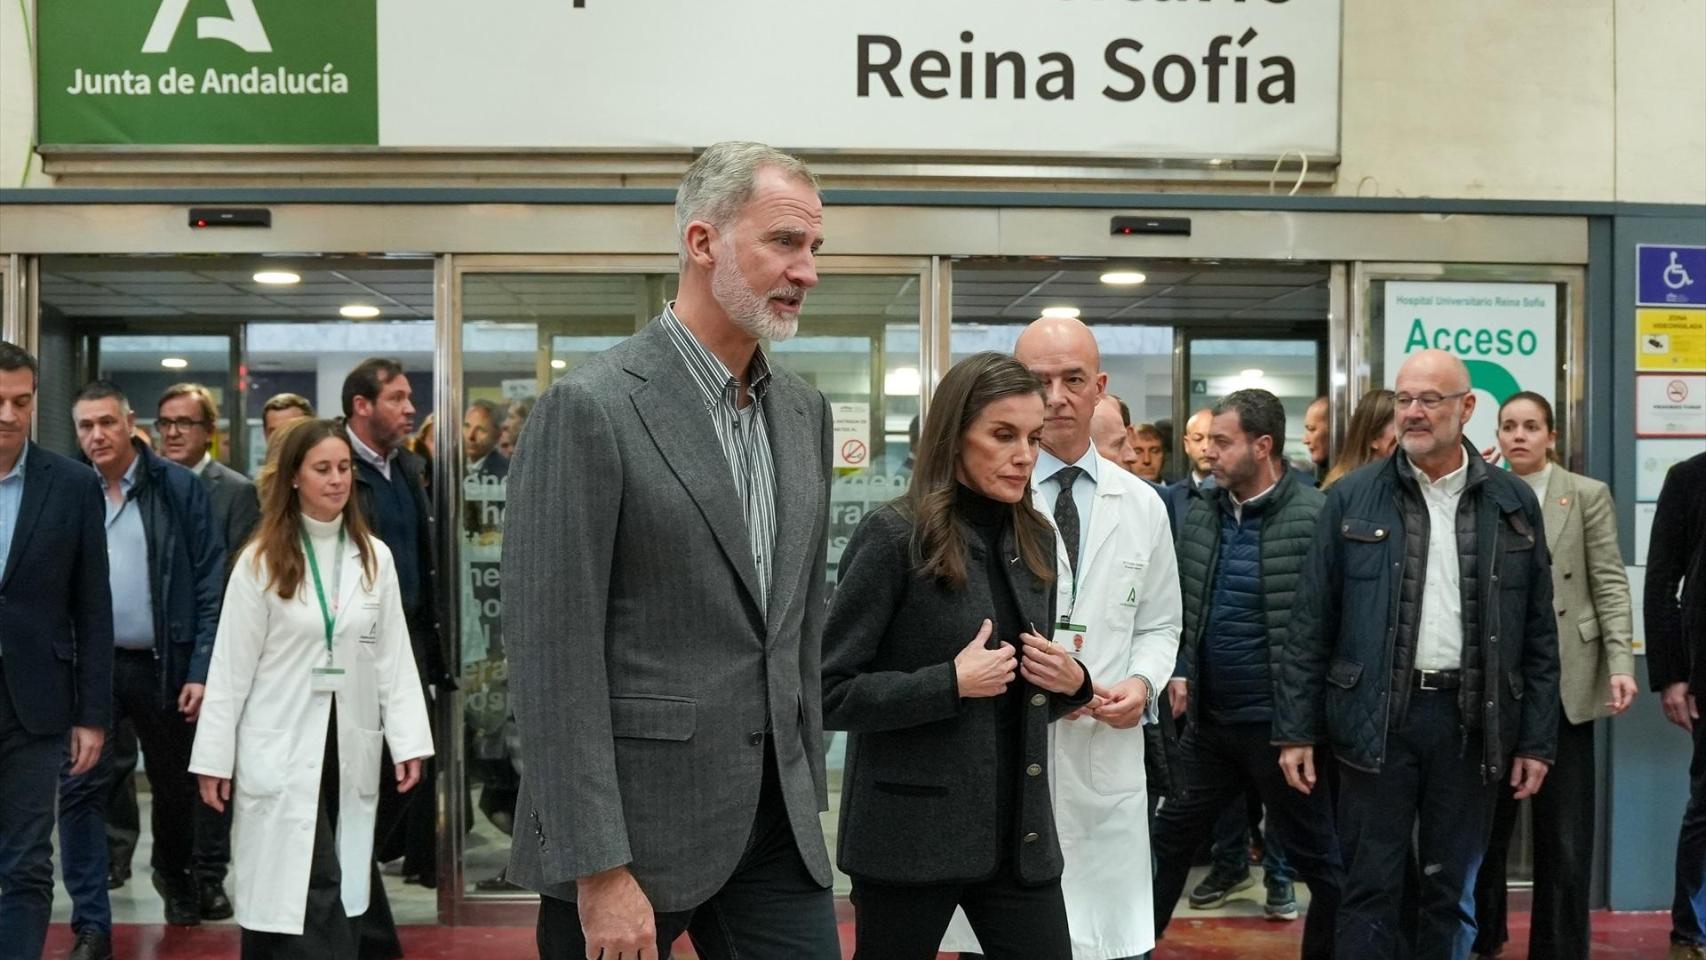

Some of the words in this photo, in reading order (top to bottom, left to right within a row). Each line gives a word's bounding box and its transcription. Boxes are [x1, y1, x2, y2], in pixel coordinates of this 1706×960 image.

[67, 68, 151, 95] Junta
[158, 67, 195, 94] de
[200, 63, 349, 94] Andalucía
[856, 30, 1075, 100] Reina
[1102, 26, 1296, 104] Sofía
[1396, 296, 1433, 307] Hospital
[1404, 318, 1538, 356] Acceso
